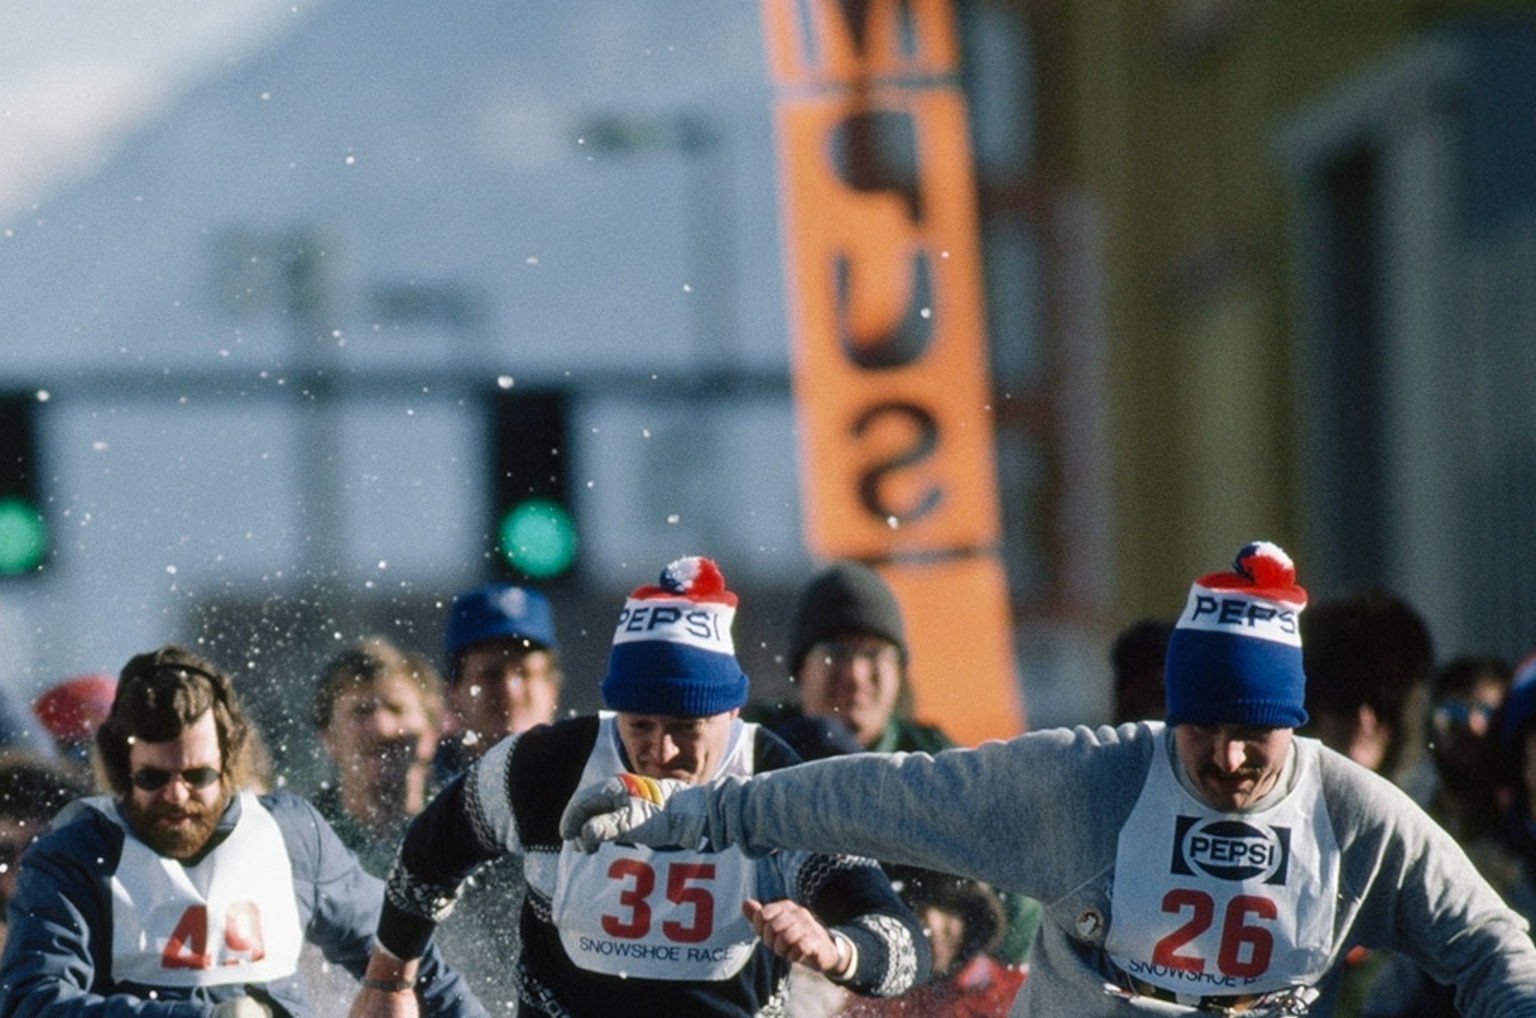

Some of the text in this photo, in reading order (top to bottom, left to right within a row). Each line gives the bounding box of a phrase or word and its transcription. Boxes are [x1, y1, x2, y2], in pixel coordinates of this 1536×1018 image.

[1190, 836, 1275, 866] PEPSI
[600, 857, 717, 944] 35
[579, 936, 735, 963] SNOWSHOE RACE
[1151, 887, 1278, 979] 26
